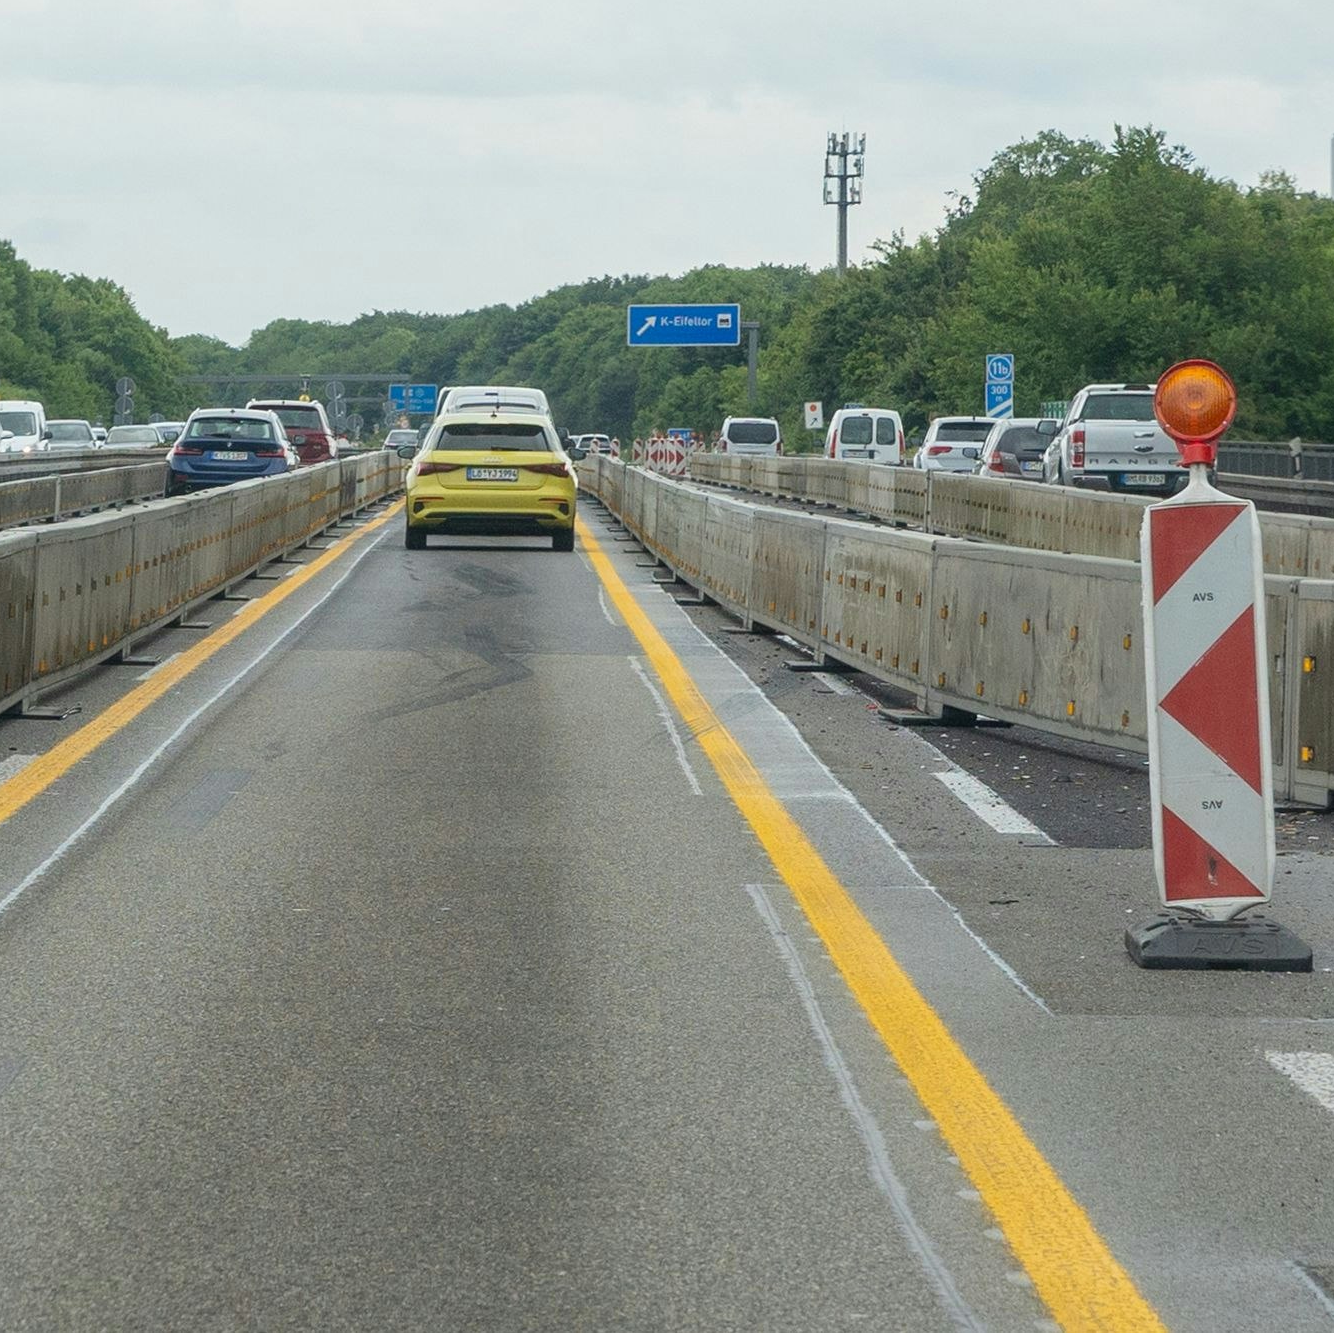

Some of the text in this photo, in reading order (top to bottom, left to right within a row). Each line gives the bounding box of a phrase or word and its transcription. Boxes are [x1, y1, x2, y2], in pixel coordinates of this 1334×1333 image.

[660, 315, 713, 327] K-Eifeltor
[992, 361, 1008, 375] 11b
[990, 385, 1008, 395] 300
[1192, 592, 1214, 602] AVS
[1202, 800, 1223, 810] AVS
[1191, 938, 1265, 955] AVS
